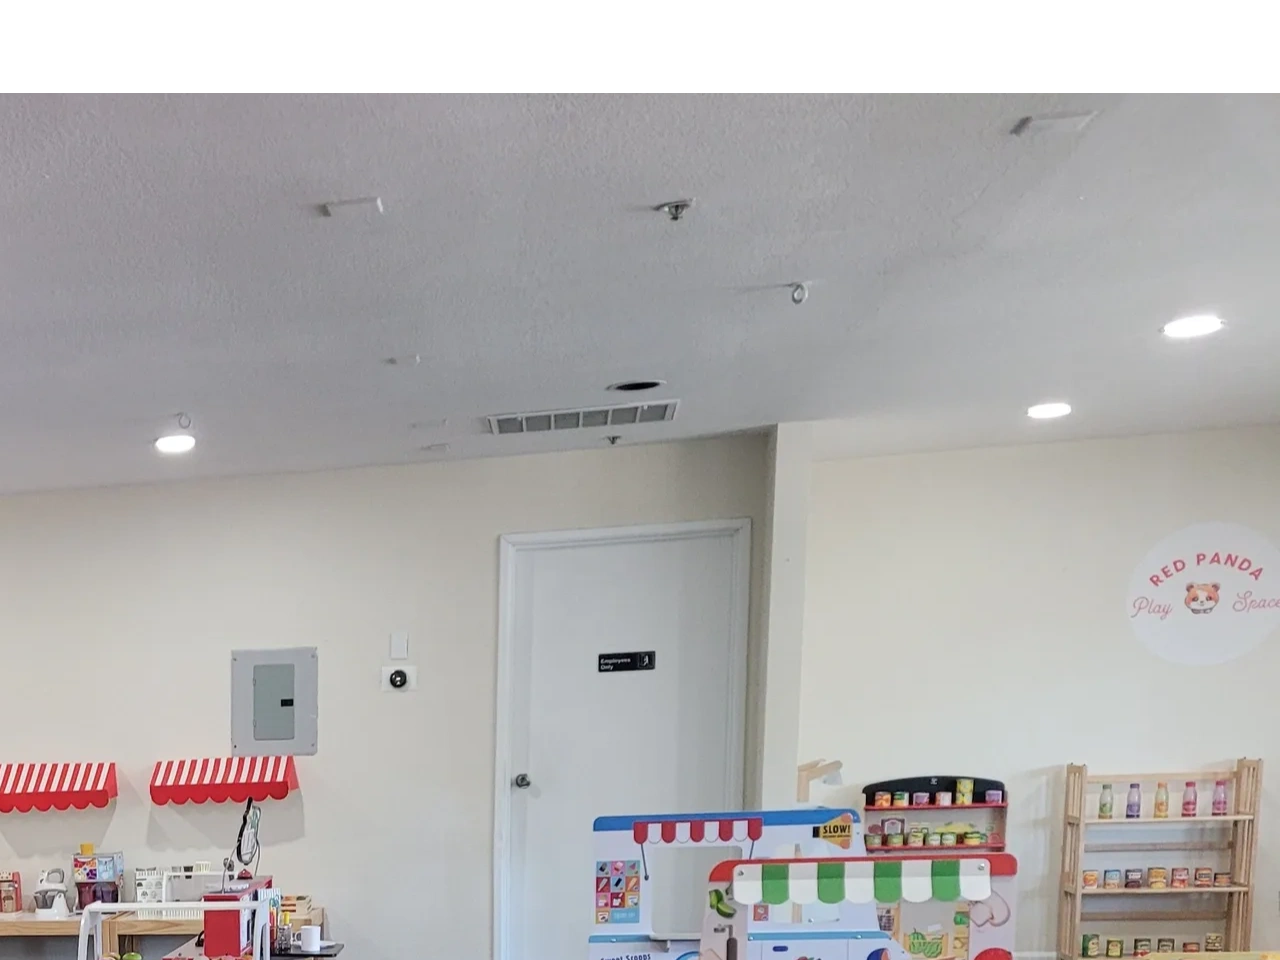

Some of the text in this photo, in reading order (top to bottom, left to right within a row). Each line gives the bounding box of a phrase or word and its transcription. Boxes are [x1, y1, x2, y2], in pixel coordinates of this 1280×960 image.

[1149, 551, 1264, 587] RED PANDA
[1130, 596, 1174, 620] Play
[822, 824, 852, 834] SLOW!
